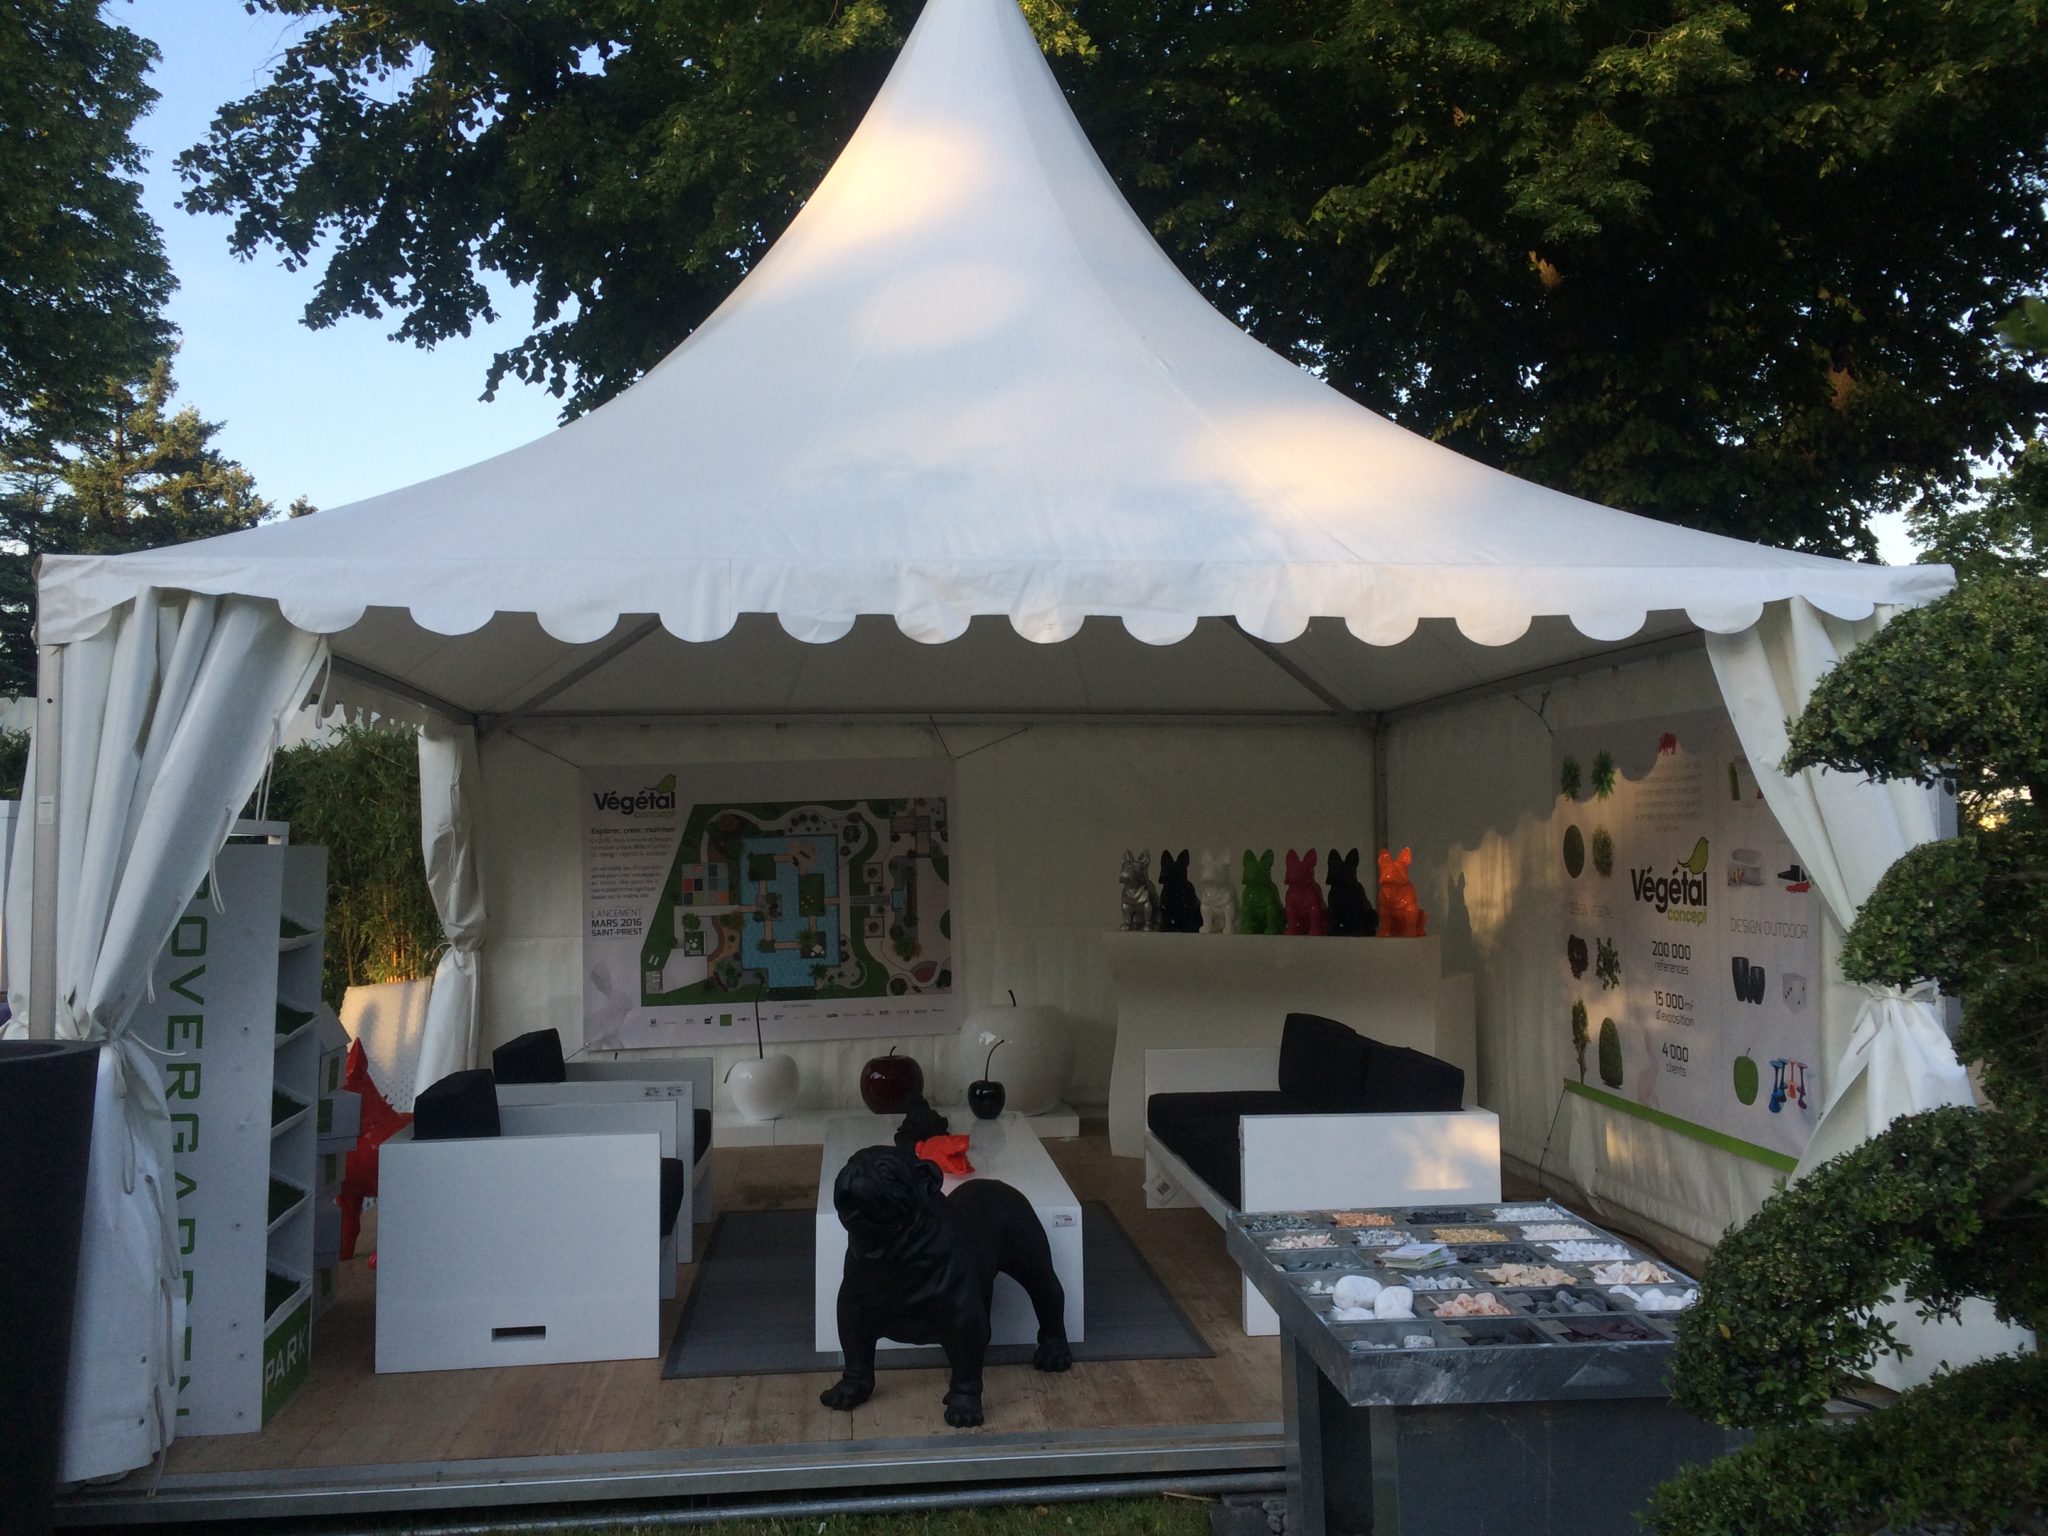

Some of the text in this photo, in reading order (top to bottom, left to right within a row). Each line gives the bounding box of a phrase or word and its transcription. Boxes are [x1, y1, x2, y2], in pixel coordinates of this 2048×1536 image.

[593, 789, 676, 815] Végétal
[1630, 865, 1707, 914] Végétal
[591, 918, 642, 928] MARS 2016
[1667, 907, 1707, 926] concept
[591, 928, 643, 937] SAINT-PRIEST
[1730, 917, 1808, 939] DESIGN OUTDOOR
[1652, 940, 1691, 961] 200 000
[264, 1322, 309, 1398] PARK
